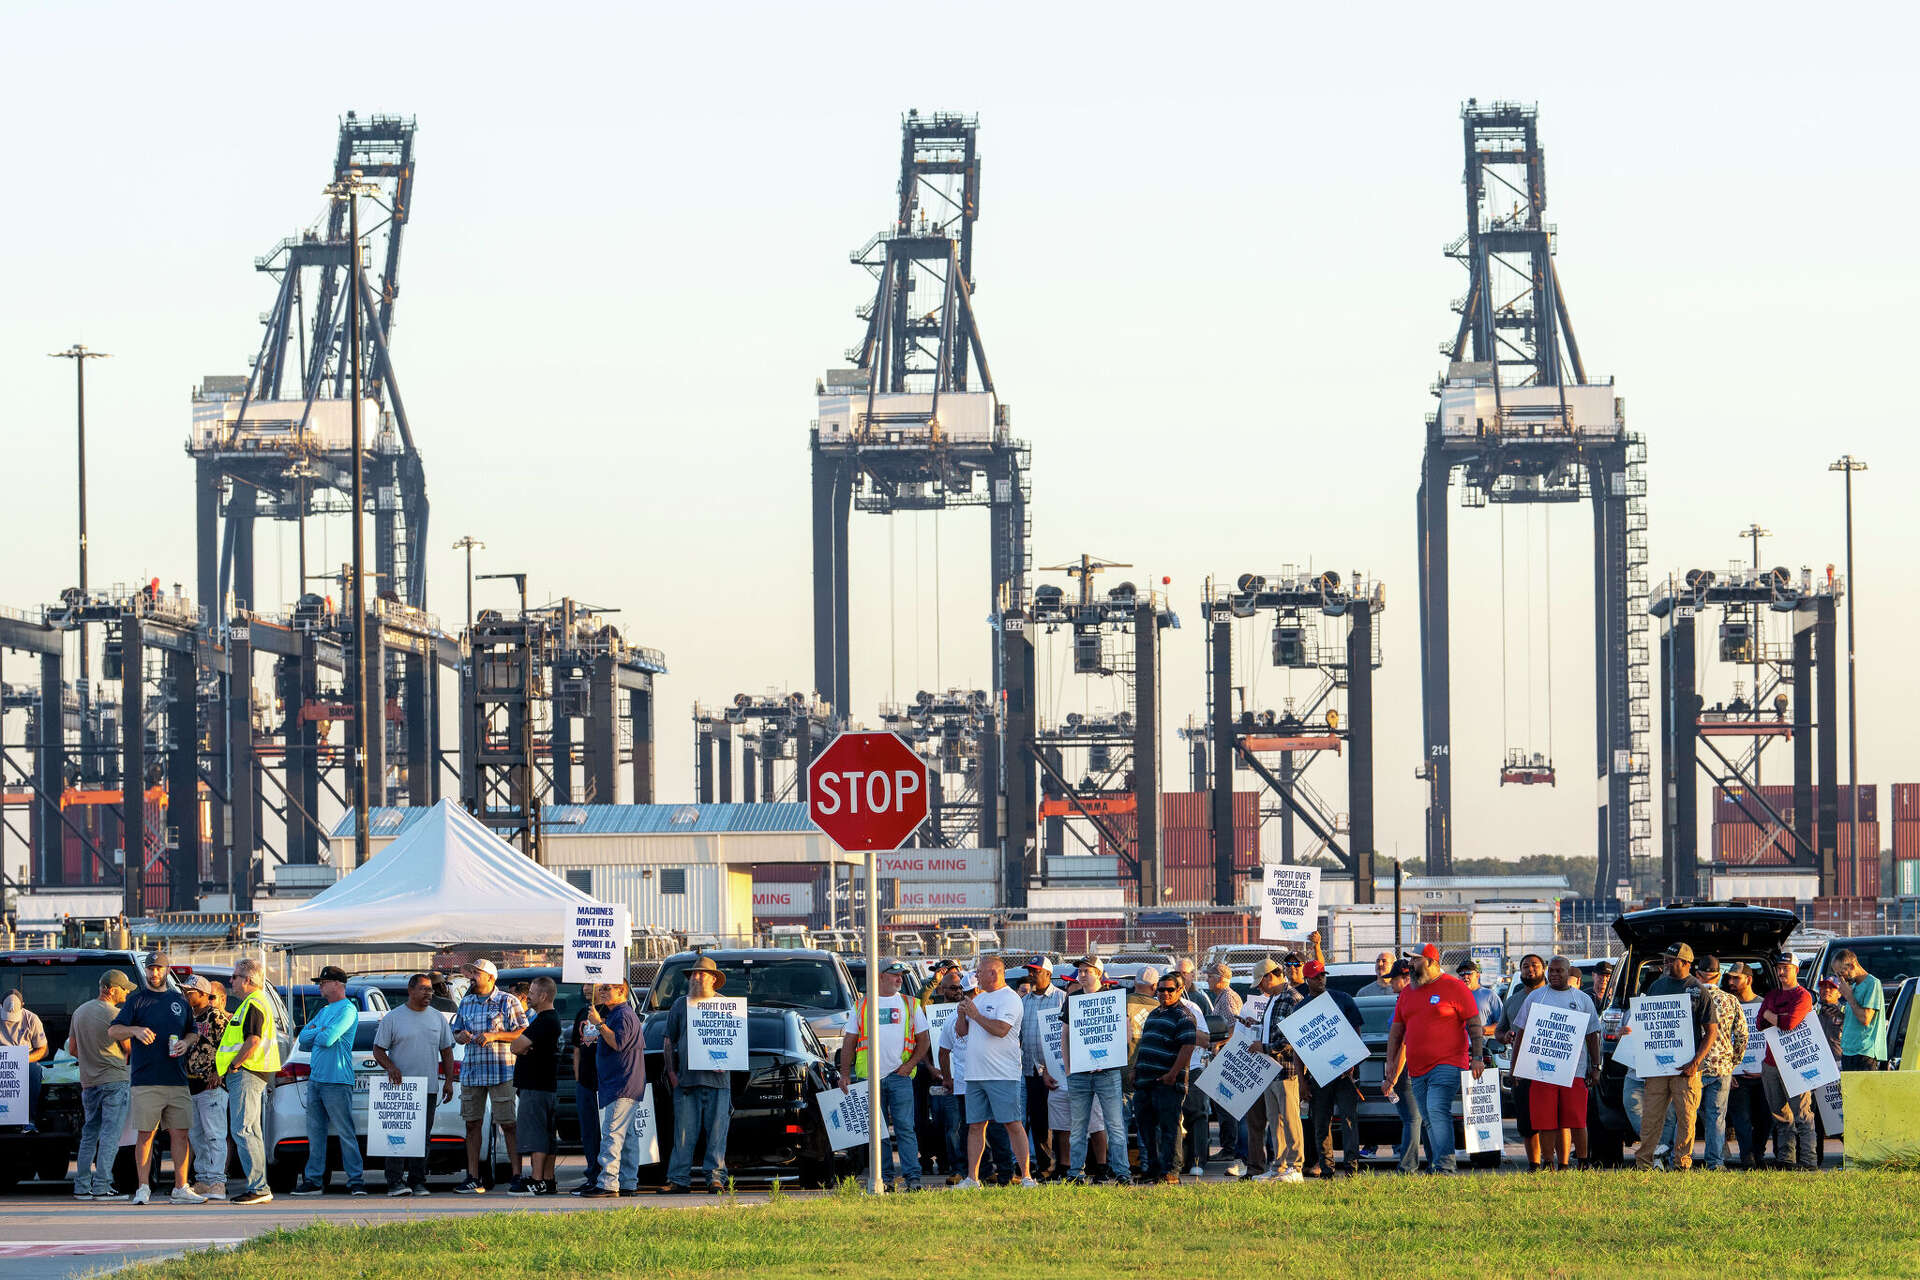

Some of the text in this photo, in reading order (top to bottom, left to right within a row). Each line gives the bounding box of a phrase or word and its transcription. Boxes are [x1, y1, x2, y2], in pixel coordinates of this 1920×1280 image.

[1215, 612, 1230, 621] 145
[1007, 621, 1022, 630] 127
[1432, 745, 1448, 755] 214
[817, 770, 919, 814] STOP
[885, 859, 967, 871] YANG MING
[1273, 870, 1311, 880] PROFIT OVER
[1277, 880, 1306, 889] PEOPLE IS
[753, 893, 791, 904] MING
[900, 893, 967, 904] NG MING
[1272, 897, 1309, 907] SUPPORT ILA
[577, 906, 613, 915] MACHINES
[1275, 906, 1304, 916] WORKERS
[576, 917, 614, 927] DON'T FEED
[572, 939, 616, 949] SUPPORT ILA
[577, 951, 611, 960] WORKERS
[697, 1002, 737, 1011] PROFIT OVER
[1079, 996, 1116, 1009] PROFIT OVER
[1640, 1000, 1681, 1012] AUTOMATION
[702, 1011, 725, 1019] PEOPLE
[1083, 1006, 1112, 1017] PEOPLE IS
[1635, 1010, 1688, 1021] HURTS FAMILIES:
[1073, 1014, 1121, 1028] UNACCEPTABLE:
[1549, 1012, 1569, 1023] FIGHT
[692, 1020, 742, 1028] UNACCEPTABLE:
[1298, 1012, 1327, 1035] NO WORK
[1535, 1019, 1577, 1035] AUTOMATION,
[1644, 1020, 1680, 1031] ILA STANDS
[697, 1028, 737, 1037] SUPPORT ILA
[1079, 1024, 1117, 1037] SUPPORT ILA
[1295, 1014, 1342, 1048] WITHOUT A FAIR
[1537, 1028, 1554, 1039] SAVE
[1650, 1030, 1675, 1040] FOR JOB
[702, 1037, 733, 1045] WORKERS
[1083, 1034, 1113, 1045] WORKERS
[1308, 1027, 1339, 1052] CONTRACT
[1779, 1027, 1812, 1046] DON'T FEED
[1531, 1036, 1573, 1052] ILA DEMANDS
[1644, 1039, 1683, 1050] PROTECTION
[1528, 1045, 1572, 1060] JOB SECURITY
[1784, 1043, 1820, 1063] SUPPORT ILA
[1236, 1049, 1262, 1073] PEOPLE IS
[1255, 1055, 1271, 1070] OVER
[1790, 1053, 1820, 1070] WORKERS
[1223, 1050, 1264, 1086] UNACCEPTABLE:
[1222, 1060, 1255, 1089] SUPPORT ILA
[401, 1082, 417, 1091] OVER
[1220, 1069, 1247, 1093] WORKERS
[1486, 1085, 1496, 1093] OVER
[383, 1092, 413, 1100] PEOPLE IS
[373, 1101, 421, 1111] UNACCEPTABLE:
[1470, 1104, 1494, 1115] DEFEND OUR
[378, 1111, 416, 1120] SUPPORT ILA
[840, 1101, 853, 1132] WORKERS
[845, 1095, 861, 1134] SUPPORT ILA
[1476, 1115, 1484, 1123] AND
[1485, 1113, 1500, 1122] RIGHTS
[382, 1121, 412, 1129] WORKERS
